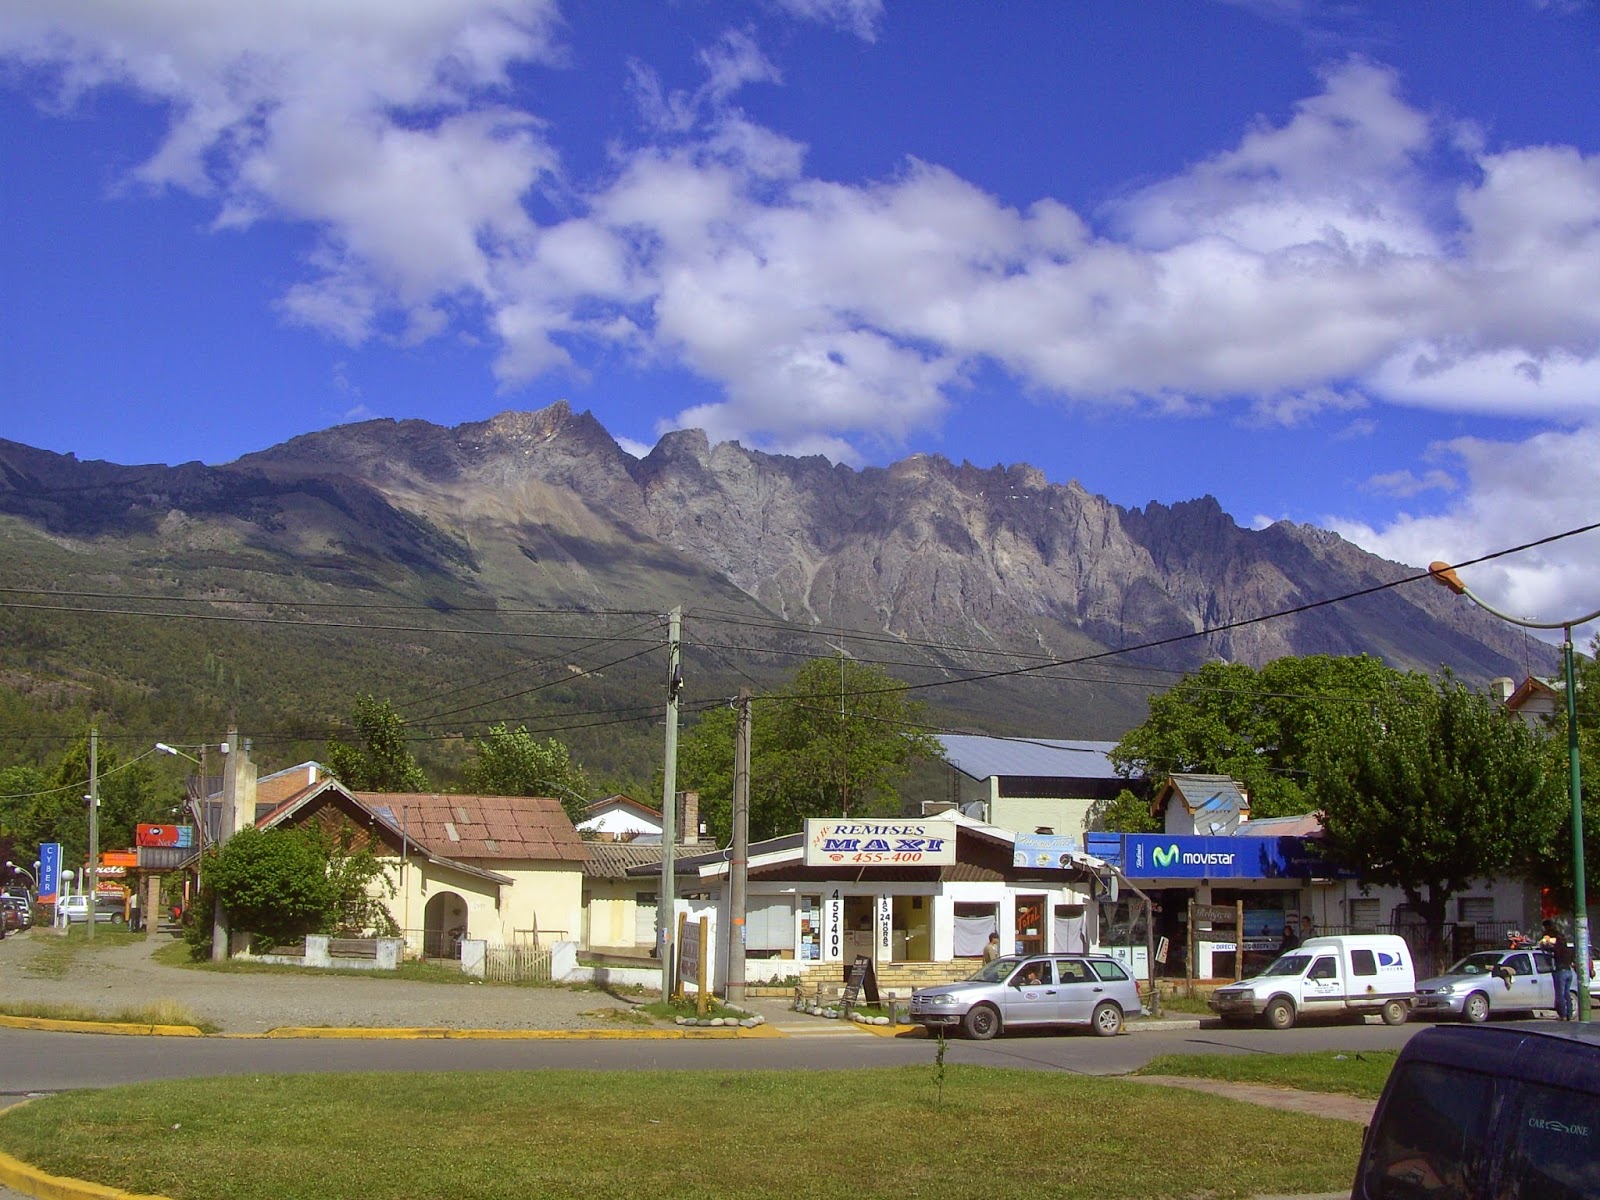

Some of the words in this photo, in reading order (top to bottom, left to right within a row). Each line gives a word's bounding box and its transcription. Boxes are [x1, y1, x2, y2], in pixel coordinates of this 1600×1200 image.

[833, 825, 925, 835] REMISES
[820, 839, 945, 852] MAXI
[852, 852, 922, 862] 455-400
[44, 846, 53, 891] CYBER
[1528, 1118, 1545, 1129] CAR
[1570, 1125, 1588, 1136] ONE
